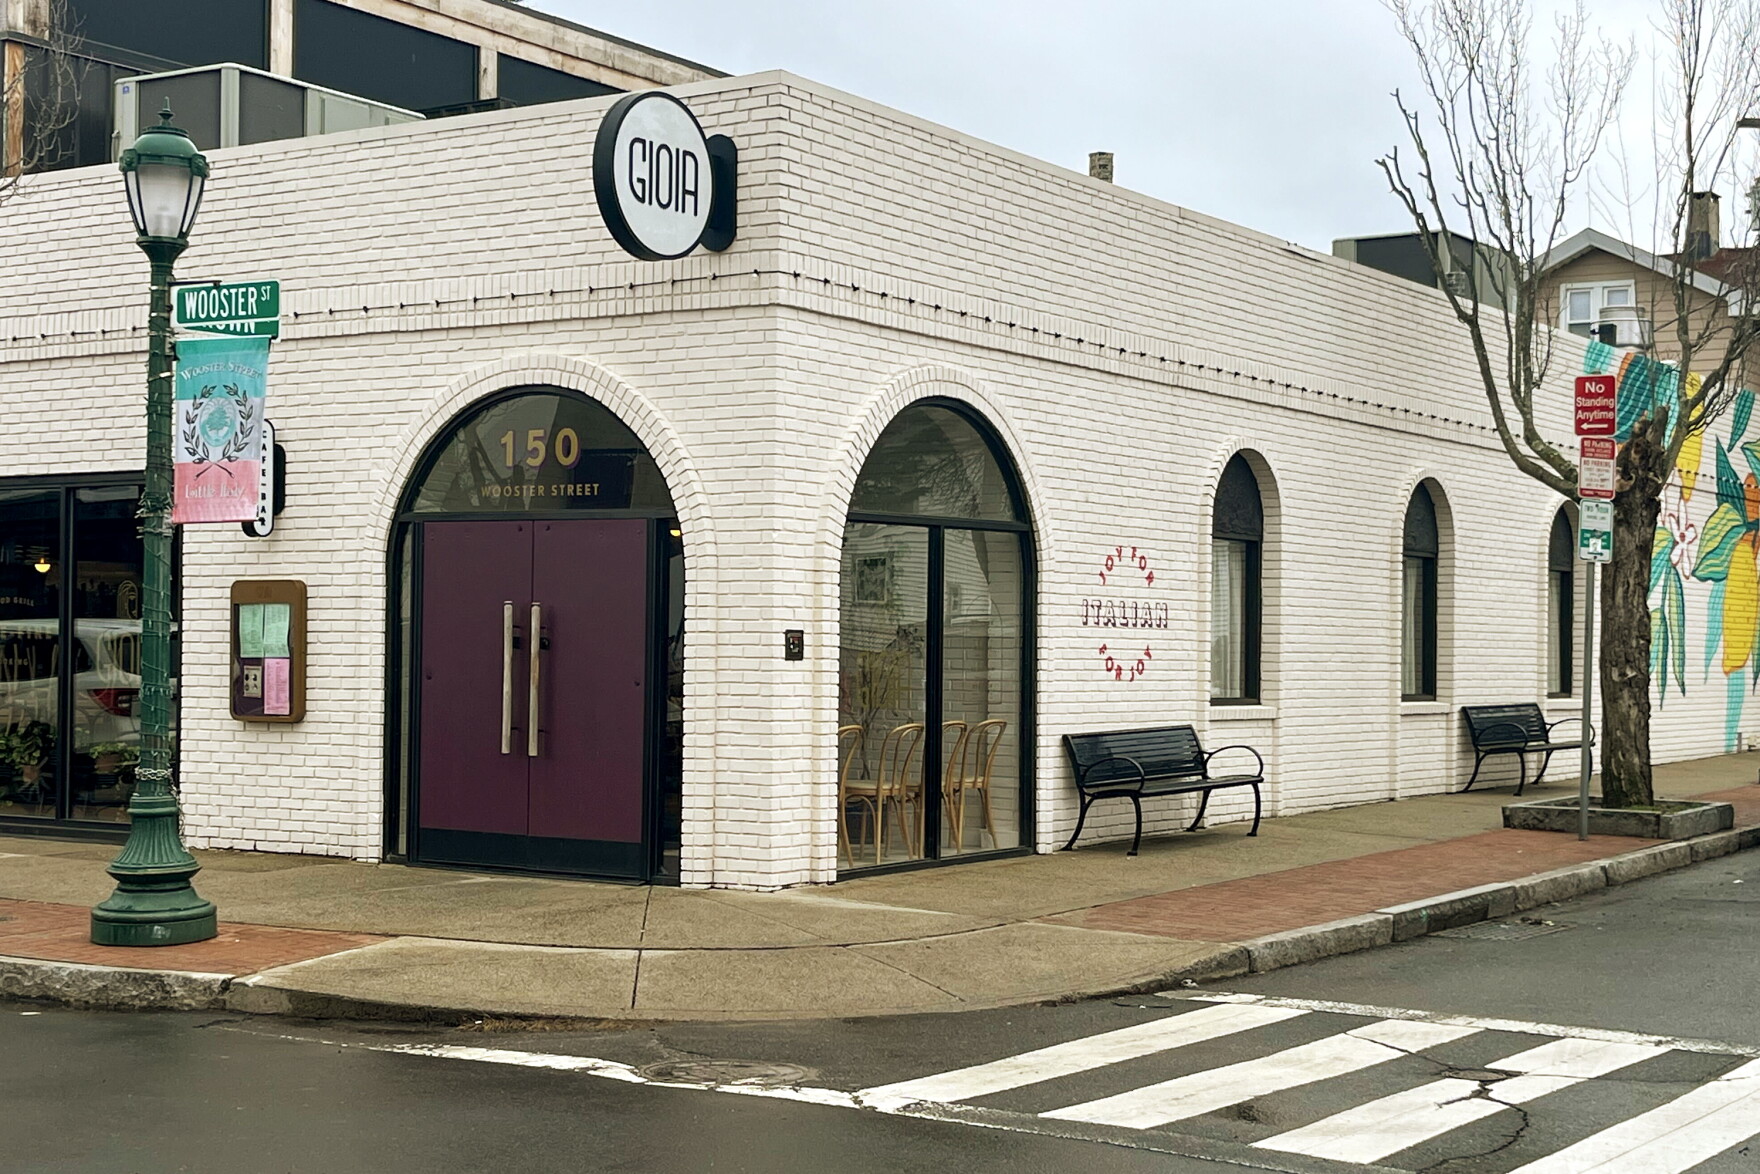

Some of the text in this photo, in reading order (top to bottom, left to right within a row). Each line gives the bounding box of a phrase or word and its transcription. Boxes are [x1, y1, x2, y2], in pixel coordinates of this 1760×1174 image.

[629, 137, 699, 217] GIOIA
[185, 285, 271, 319] WOOSTER ST
[1585, 382, 1605, 393] No
[1576, 397, 1615, 409] Standing
[1576, 410, 1615, 422] Anytime
[501, 427, 580, 468] 150
[481, 483, 600, 497] WOOSTER STREET
[1081, 599, 1168, 628] ITALIAN
